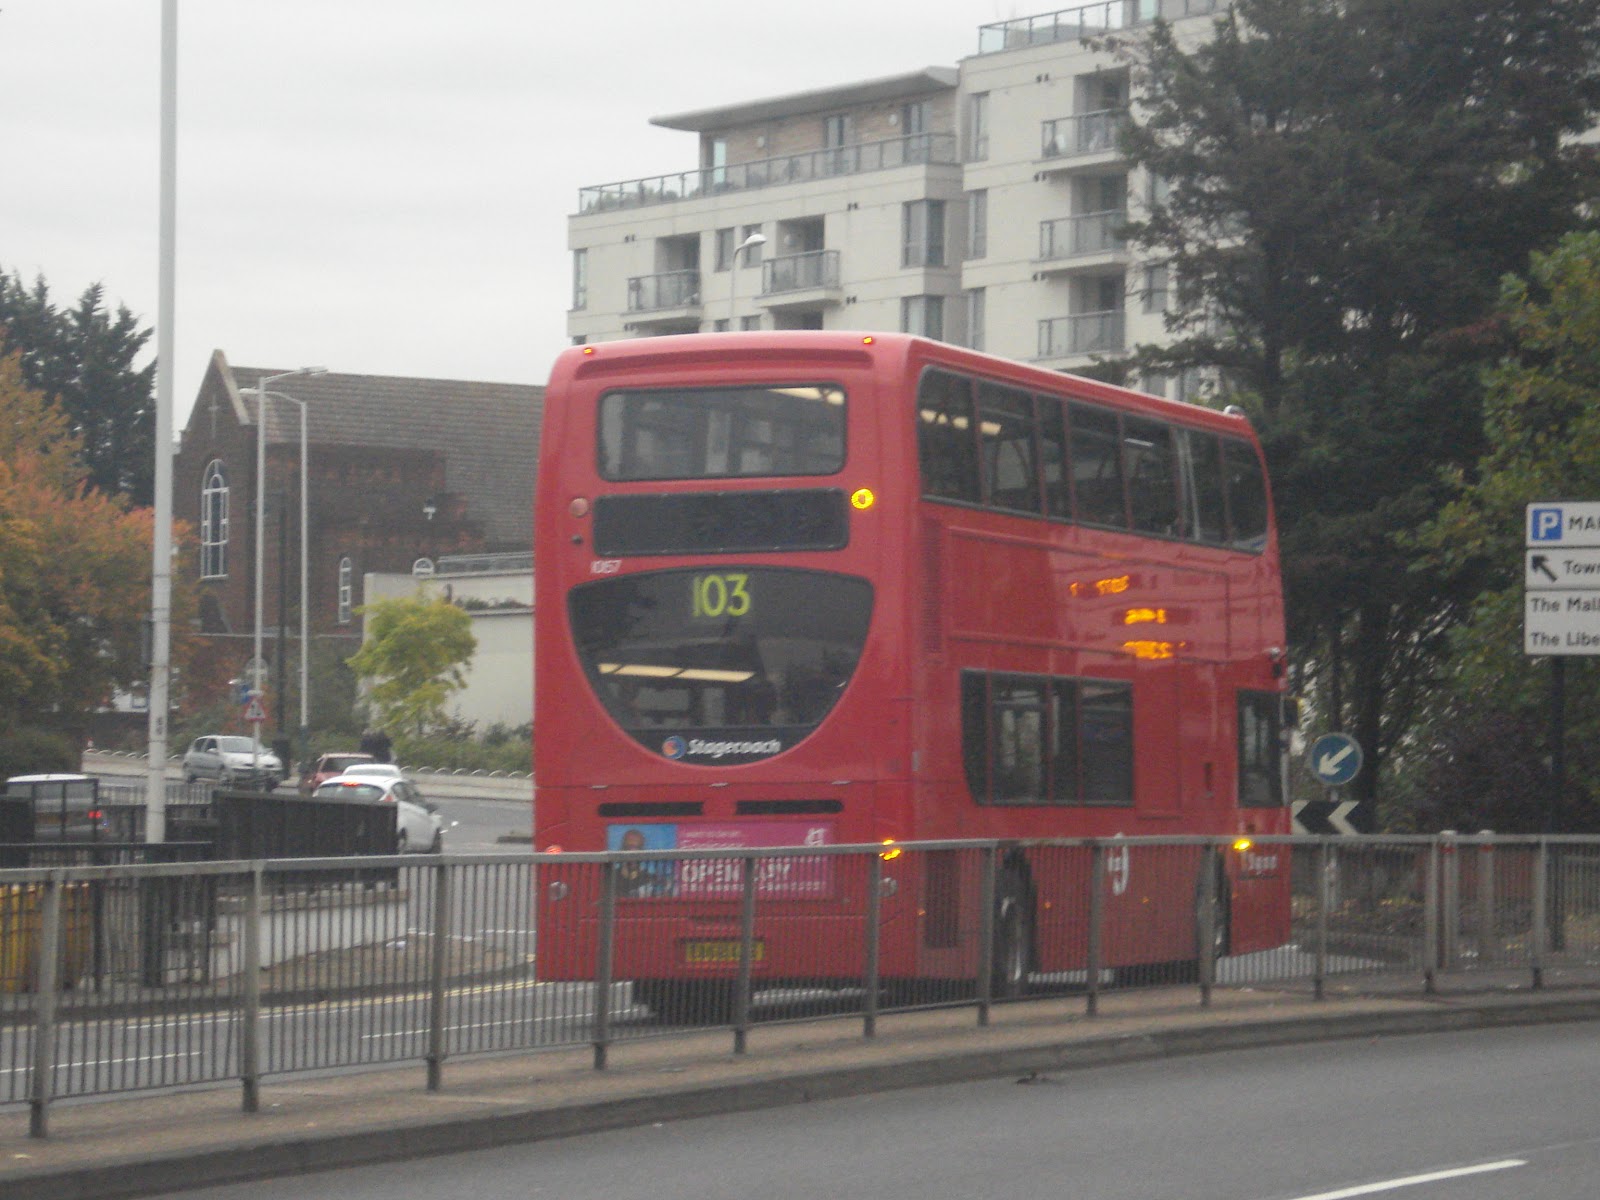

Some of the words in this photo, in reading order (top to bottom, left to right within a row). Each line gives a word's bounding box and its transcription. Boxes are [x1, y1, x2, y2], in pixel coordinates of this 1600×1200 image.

[1538, 511, 1559, 538] P
[1569, 516, 1600, 529] MA
[692, 573, 751, 617] 103
[1532, 598, 1560, 612] The
[1532, 631, 1560, 646] The
